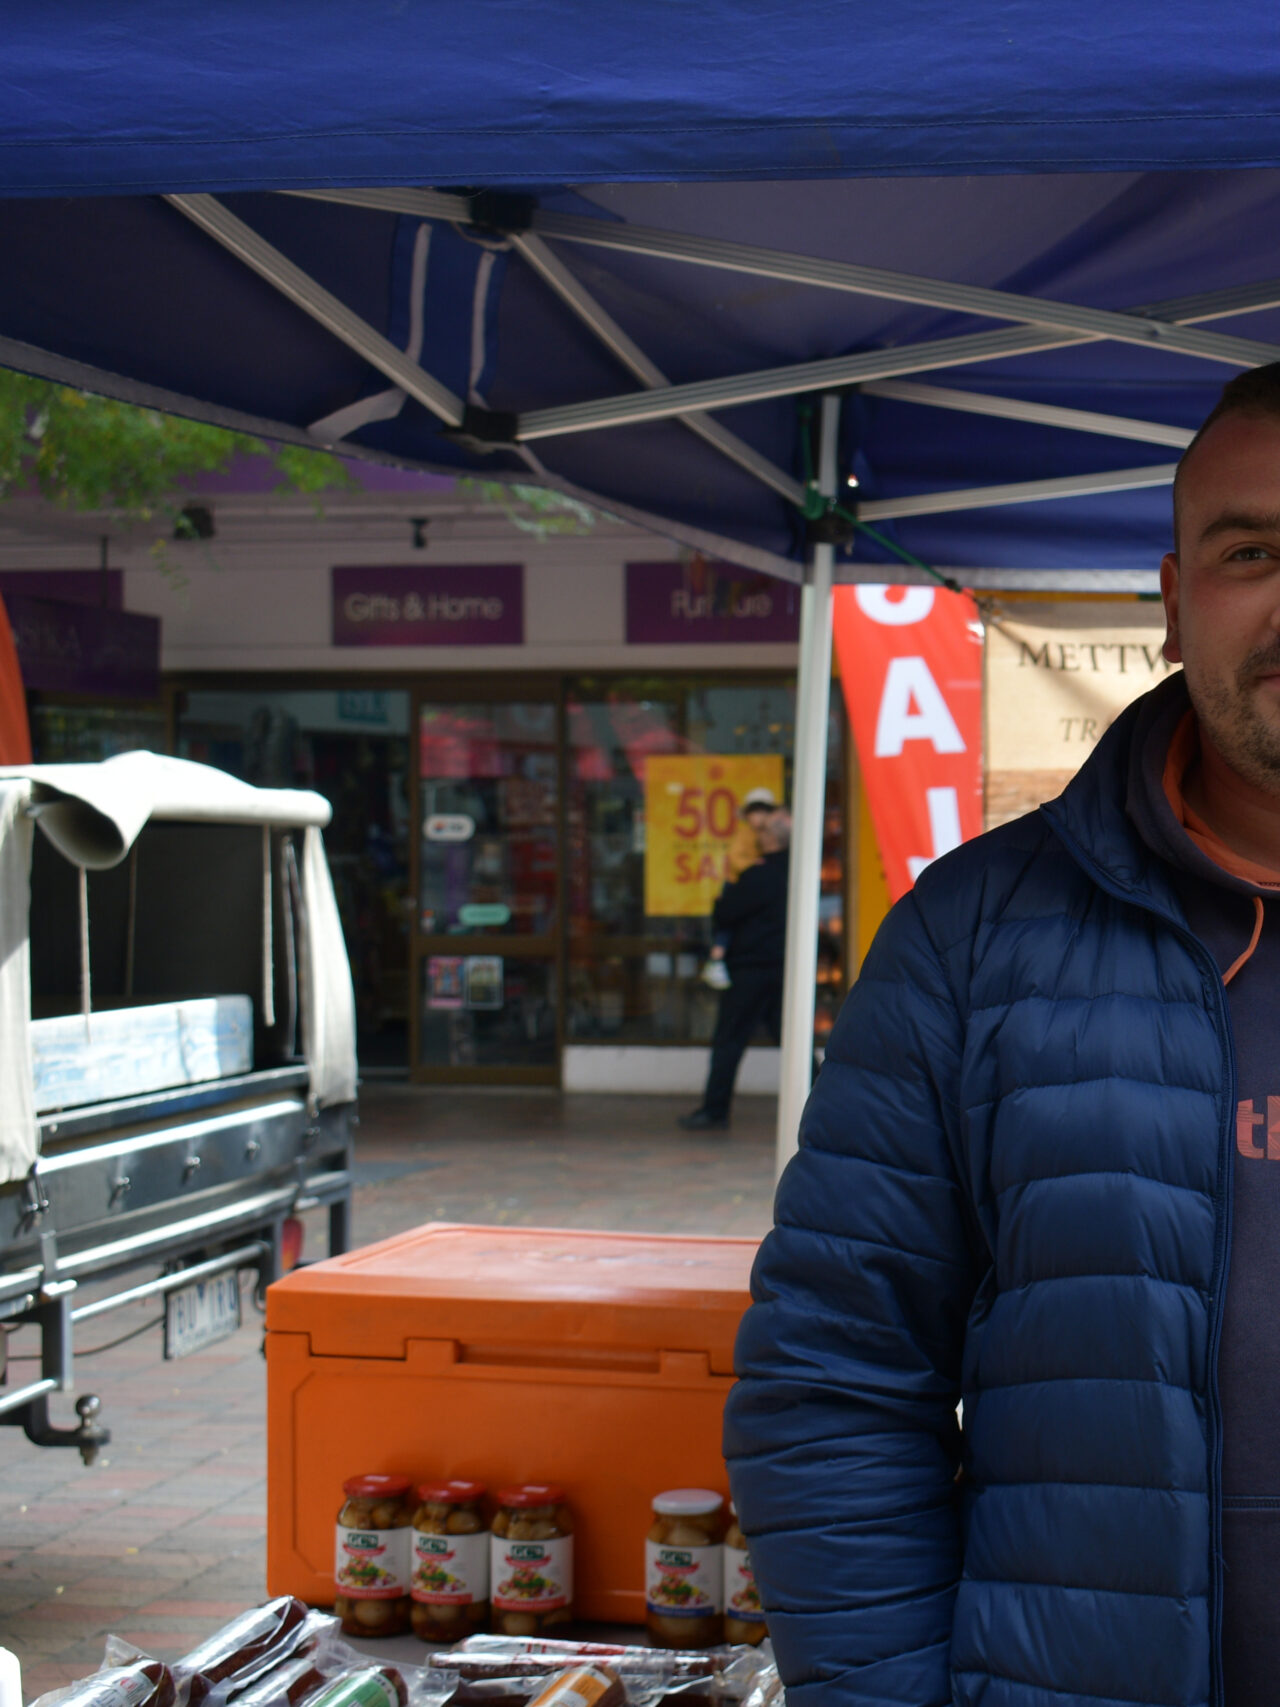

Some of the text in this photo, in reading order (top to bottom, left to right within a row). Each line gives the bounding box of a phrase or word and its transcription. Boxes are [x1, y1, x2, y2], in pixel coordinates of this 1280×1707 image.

[344, 592, 504, 622] Gifts & Home
[1018, 641, 1170, 674] METTW
[674, 785, 739, 839] 50
